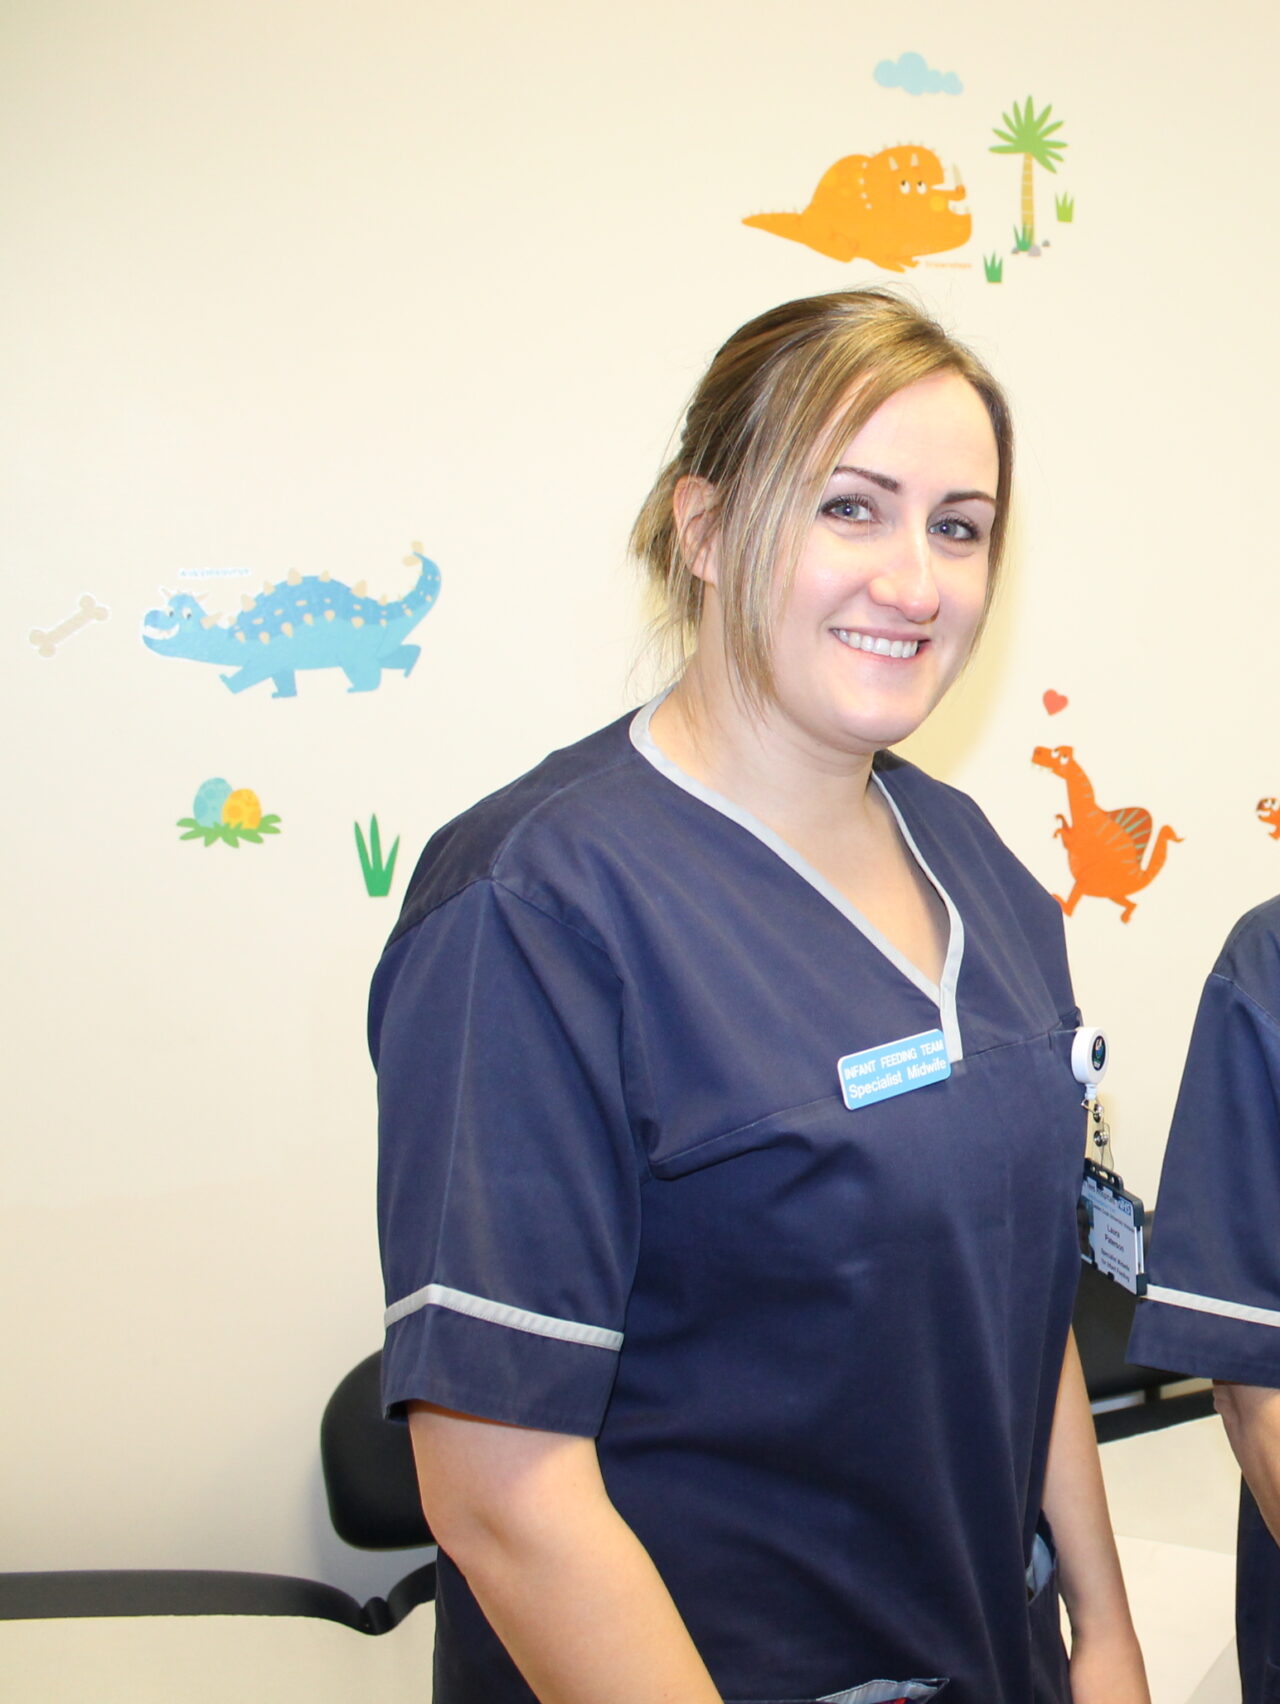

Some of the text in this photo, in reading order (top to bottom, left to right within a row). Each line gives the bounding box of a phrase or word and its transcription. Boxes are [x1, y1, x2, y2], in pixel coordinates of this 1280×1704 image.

[844, 1040, 944, 1080] INFANT FEEDING TEAM
[848, 1057, 947, 1099] Specialist Midwife
